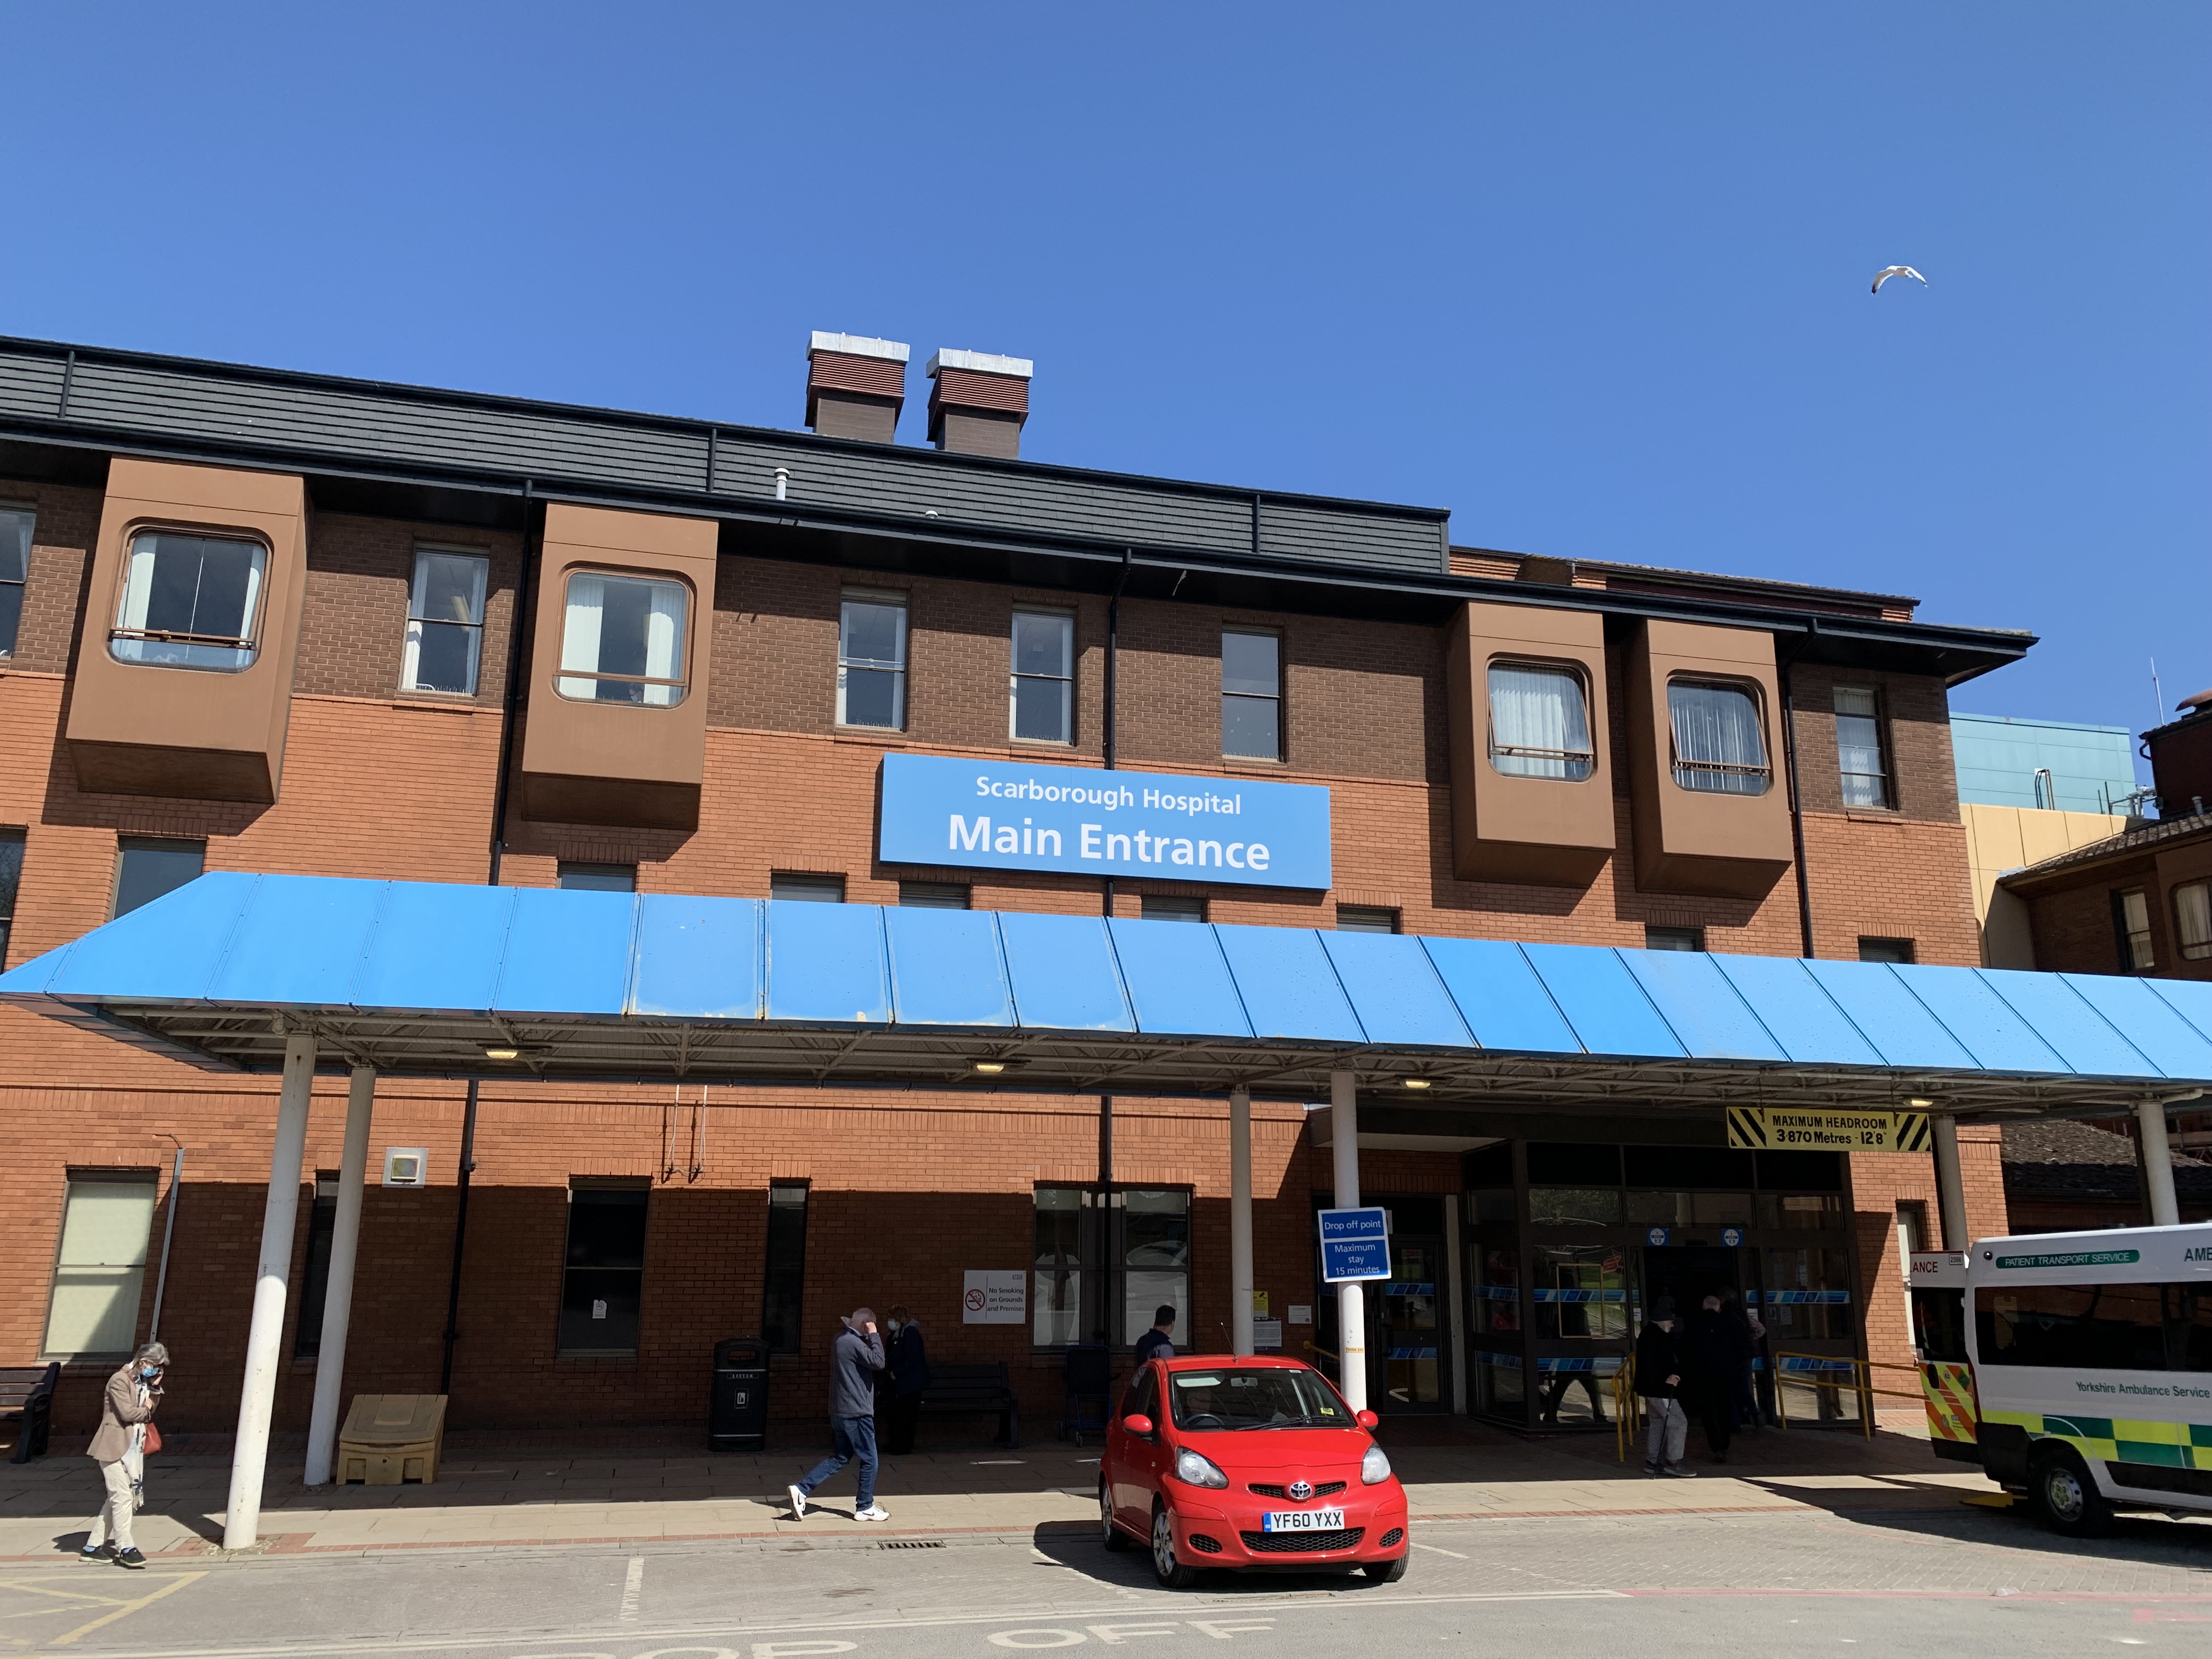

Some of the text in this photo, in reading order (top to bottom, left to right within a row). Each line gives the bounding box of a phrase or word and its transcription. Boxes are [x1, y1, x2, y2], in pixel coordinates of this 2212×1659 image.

[977, 776, 1241, 816] Scarborough Hospital
[949, 814, 1271, 871] Main Entrance
[1773, 1115, 1887, 1129] MAXIMUM HEADROOM
[1814, 1131, 1852, 1144] Metres
[1324, 1220, 1381, 1231] Drop off point
[1335, 1243, 1376, 1253] Maximum
[1348, 1256, 1364, 1265] stay
[2005, 1252, 2130, 1267] PATIENT TRANSPORT SERVICE
[1335, 1266, 1380, 1276] 15 minutes
[1910, 1261, 1938, 1273] ANCE
[2076, 1381, 2210, 1398] Yorkshire Ambulance Service
[1273, 1512, 1342, 1528] YF60 YXX
[988, 1617, 1278, 1648] OFF
